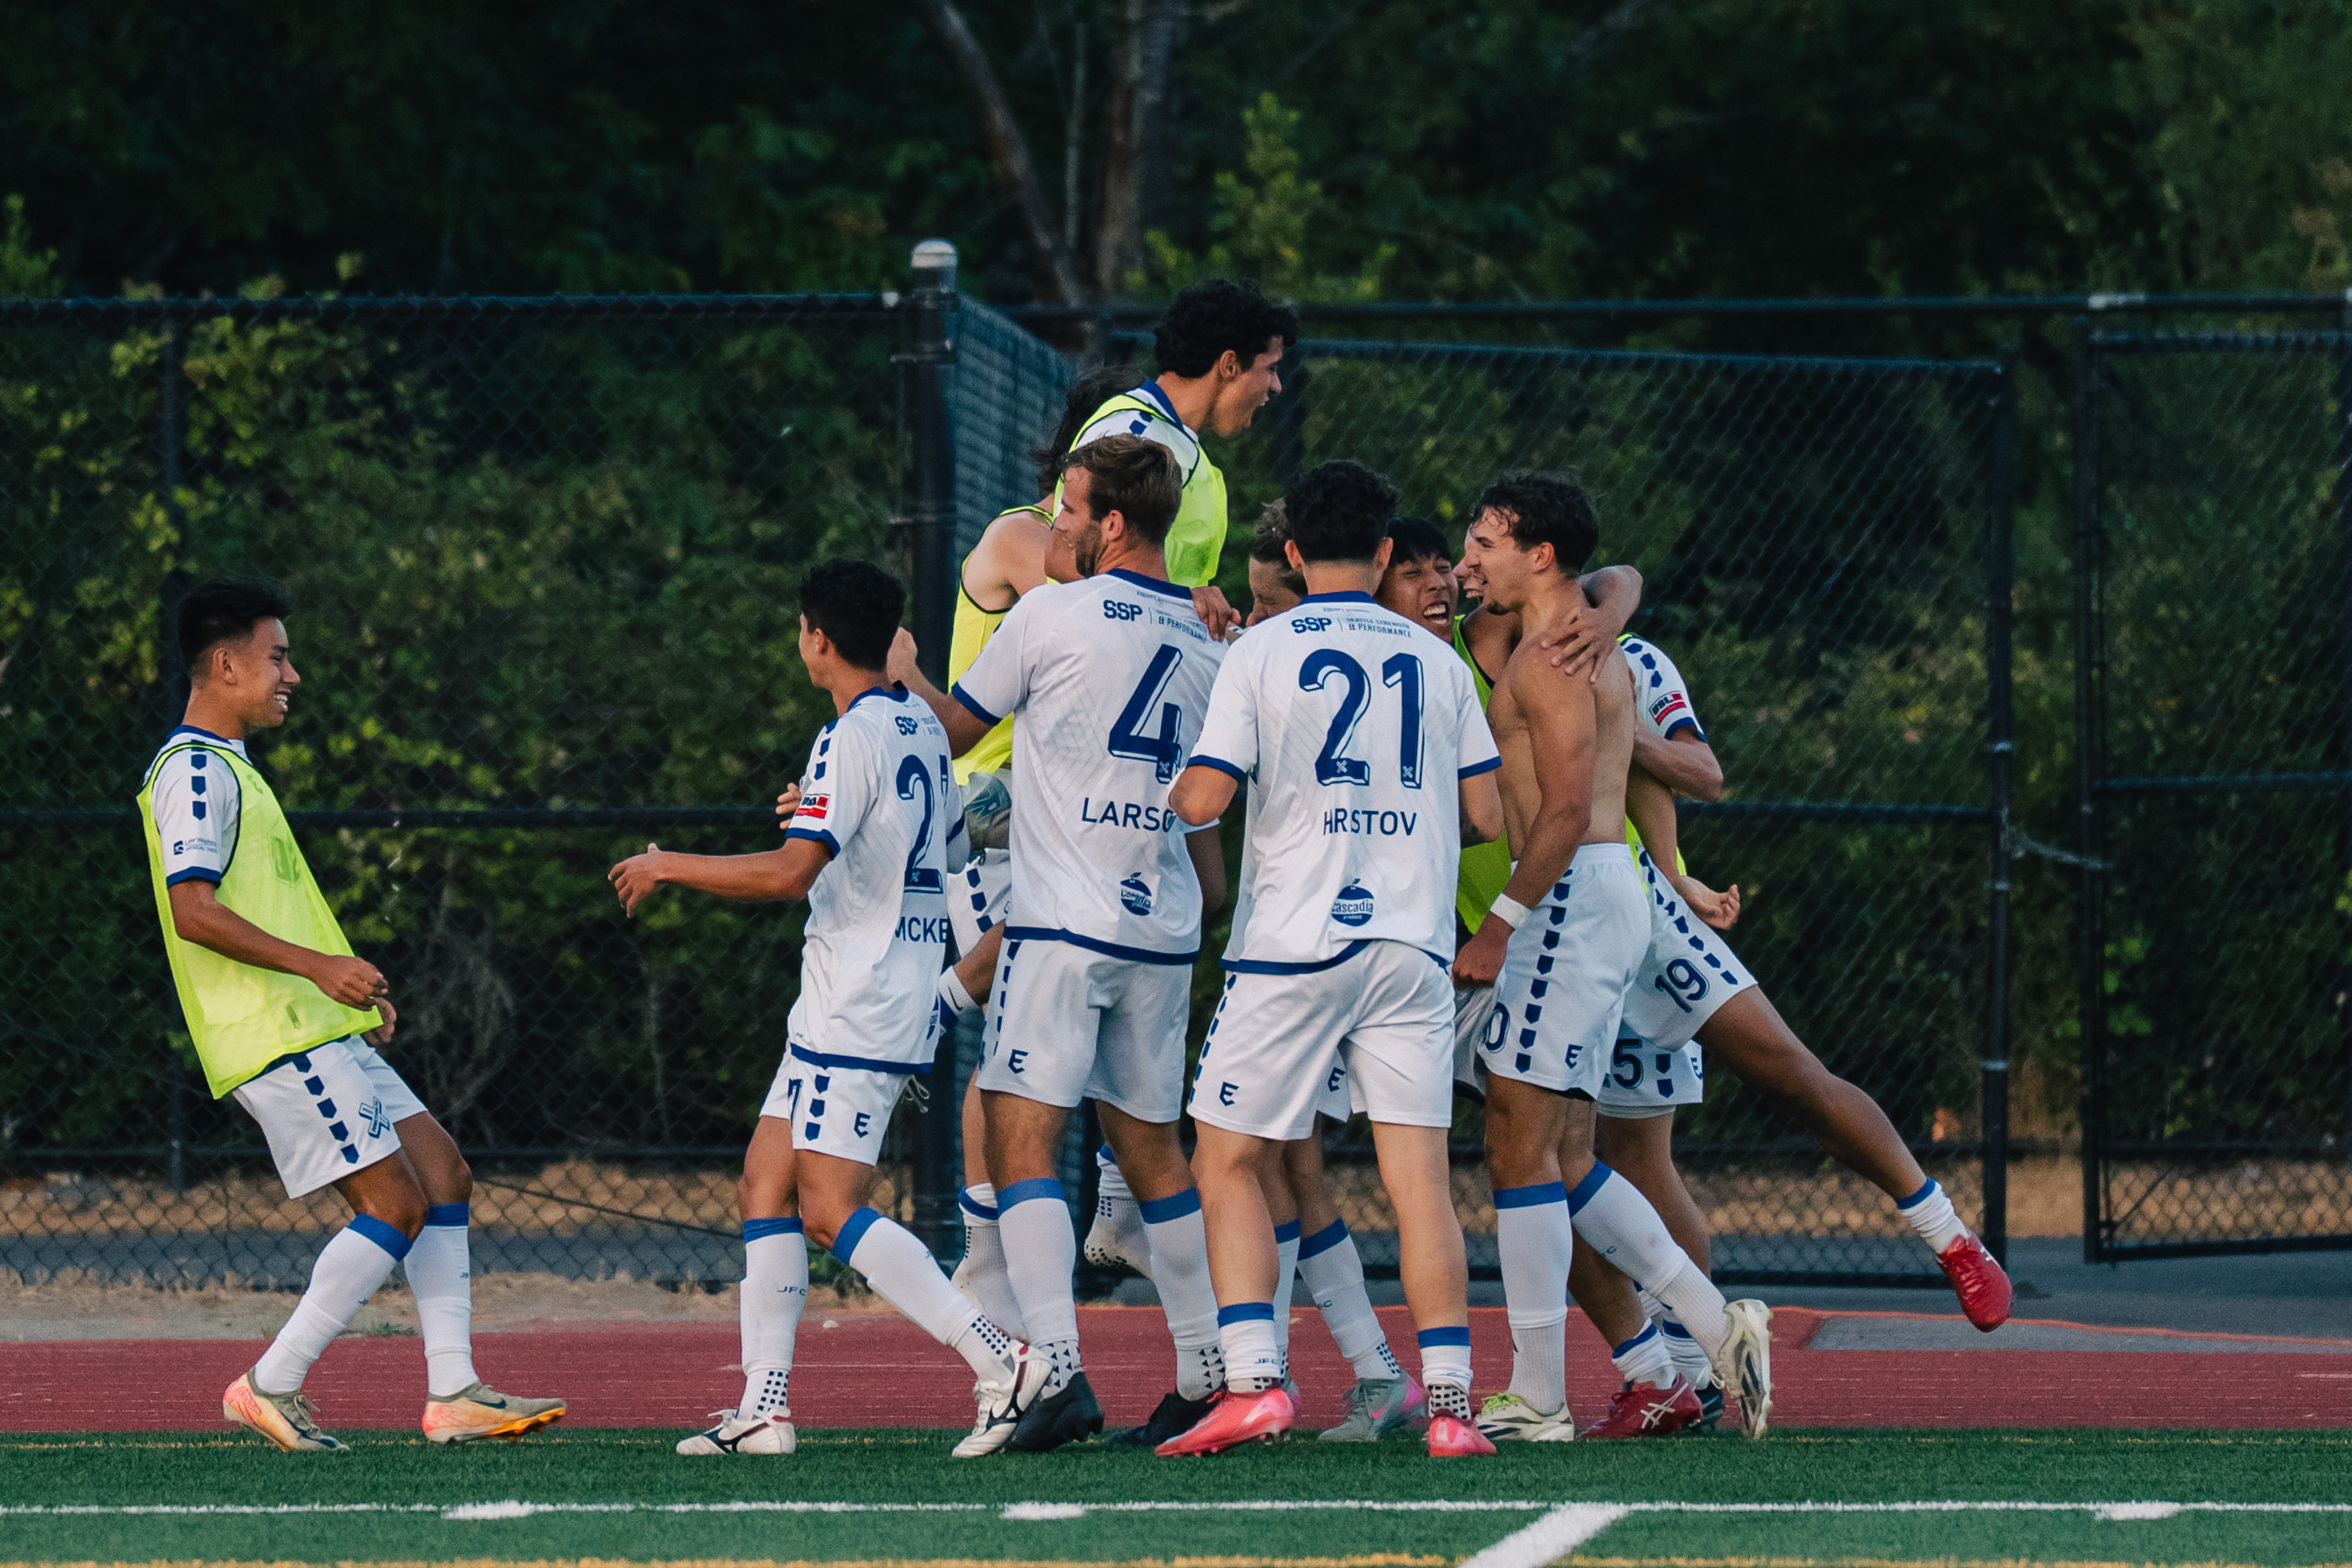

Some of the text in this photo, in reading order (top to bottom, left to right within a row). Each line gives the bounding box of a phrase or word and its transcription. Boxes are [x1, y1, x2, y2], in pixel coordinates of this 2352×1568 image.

[1103, 599, 1143, 621] SSP
[1291, 617, 1332, 634] SSP
[1358, 624, 1411, 639] PERFORMANCE
[1108, 644, 1183, 784] 4
[1299, 648, 1424, 789] 21
[1654, 958, 1710, 1014] 19
[1603, 1037, 1644, 1089] 5
